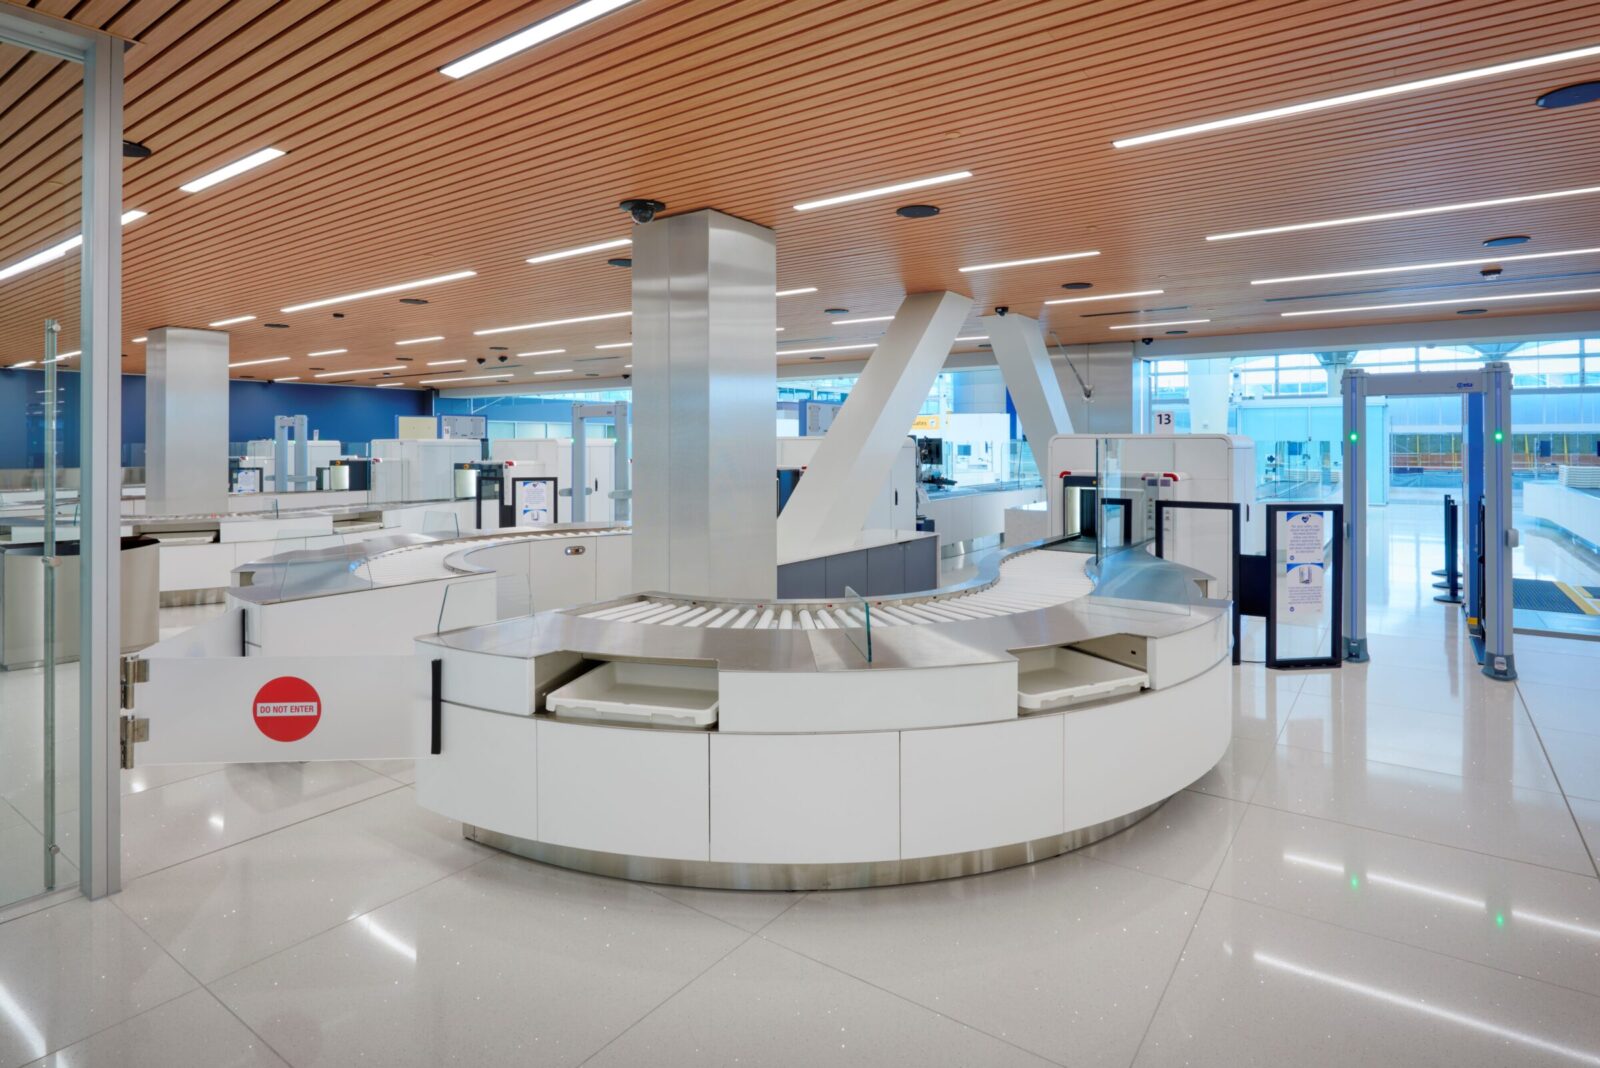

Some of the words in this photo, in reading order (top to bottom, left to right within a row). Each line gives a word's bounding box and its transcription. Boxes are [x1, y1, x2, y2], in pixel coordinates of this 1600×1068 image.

[1157, 413, 1171, 425] 13
[260, 706, 271, 714] DO
[272, 705, 288, 713] NOT
[290, 705, 314, 713] ENTER
